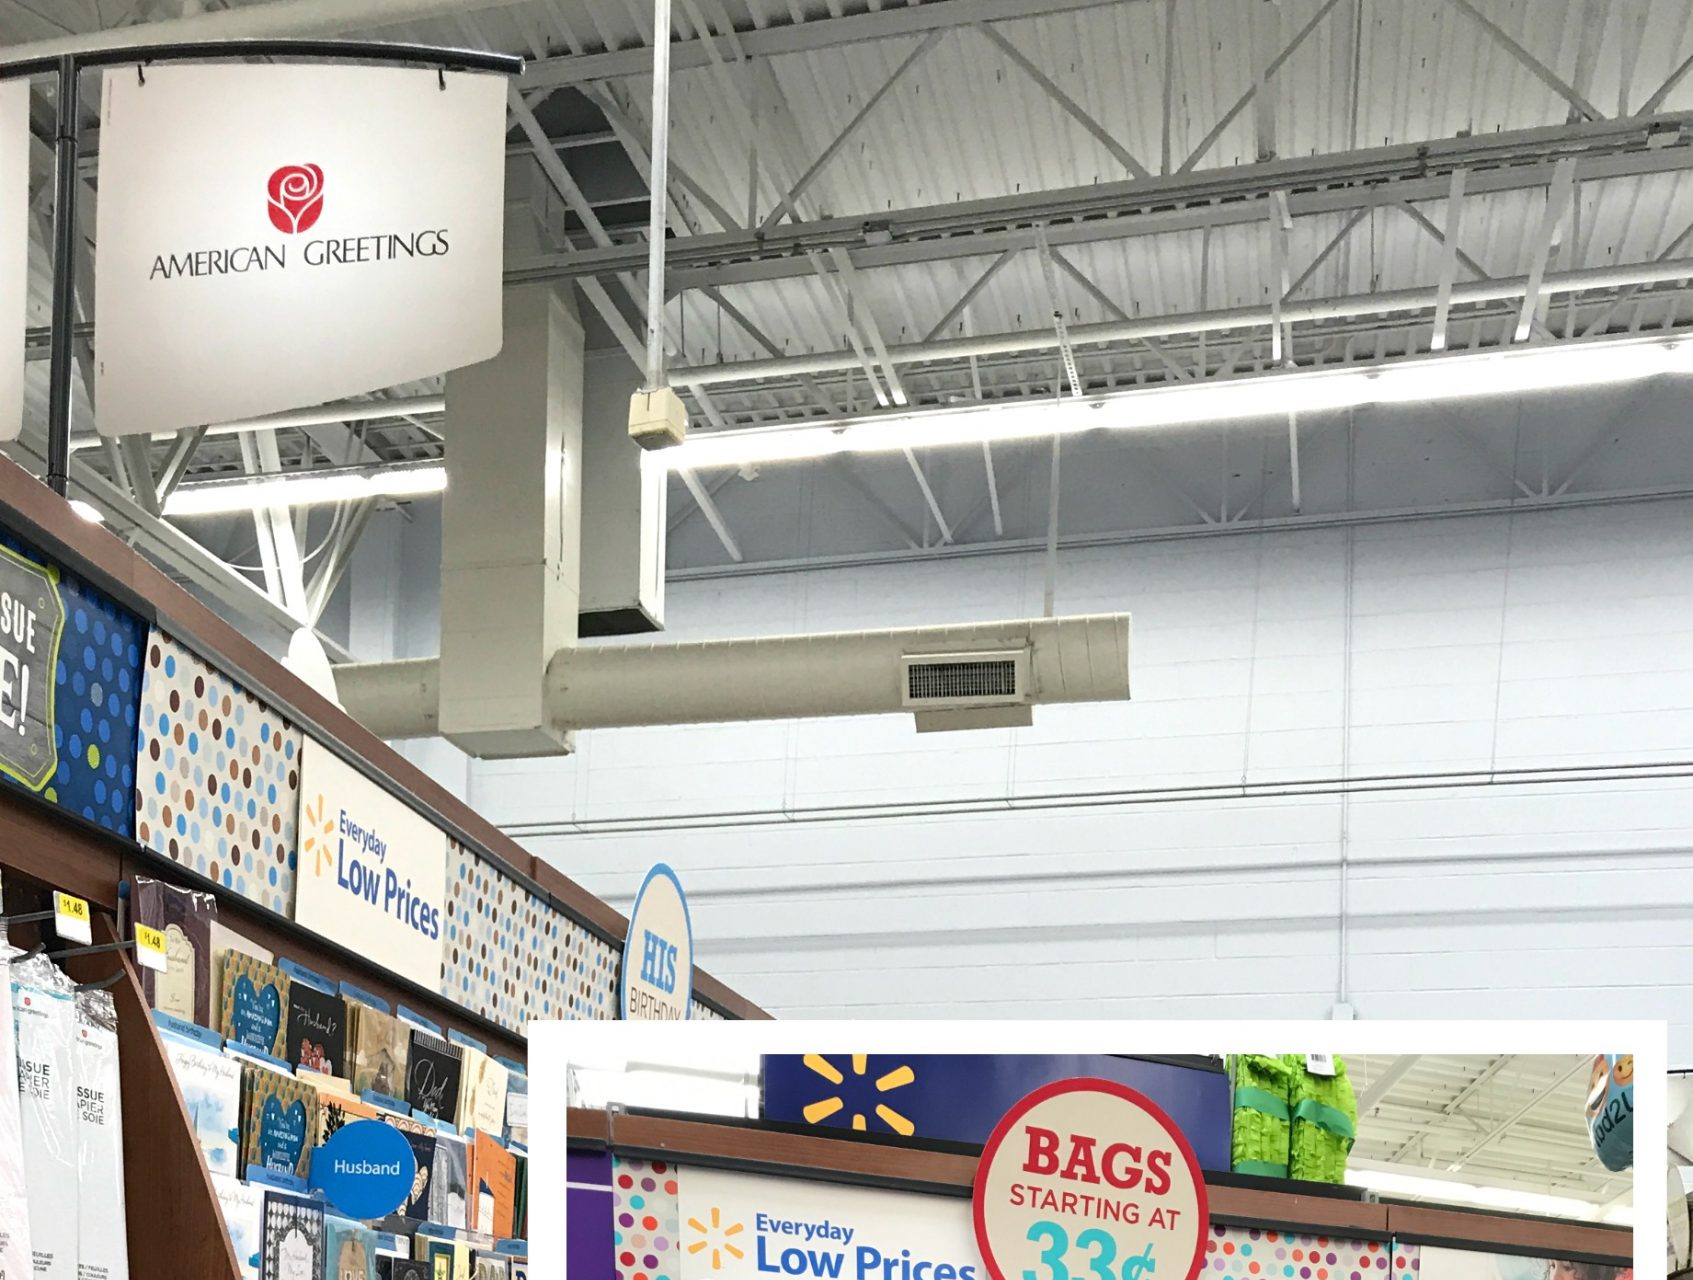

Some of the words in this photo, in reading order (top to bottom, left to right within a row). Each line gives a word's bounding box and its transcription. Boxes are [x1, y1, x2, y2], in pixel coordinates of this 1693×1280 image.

[149, 244, 286, 281] AMERICAN
[303, 228, 450, 268] GREETINGS
[338, 808, 388, 864] Everyday
[62, 898, 84, 917] $1.48
[337, 838, 382, 905] Low
[384, 879, 440, 942] Prices
[143, 931, 162, 949] $1.48
[640, 929, 678, 995] HIS
[334, 1159, 401, 1175] Husband
[1022, 1125, 1172, 1196] BAGS
[755, 1213, 855, 1249] Everyday
[1009, 1183, 1140, 1225] STARTING
[1148, 1206, 1181, 1231] AT
[755, 1236, 845, 1280] Low
